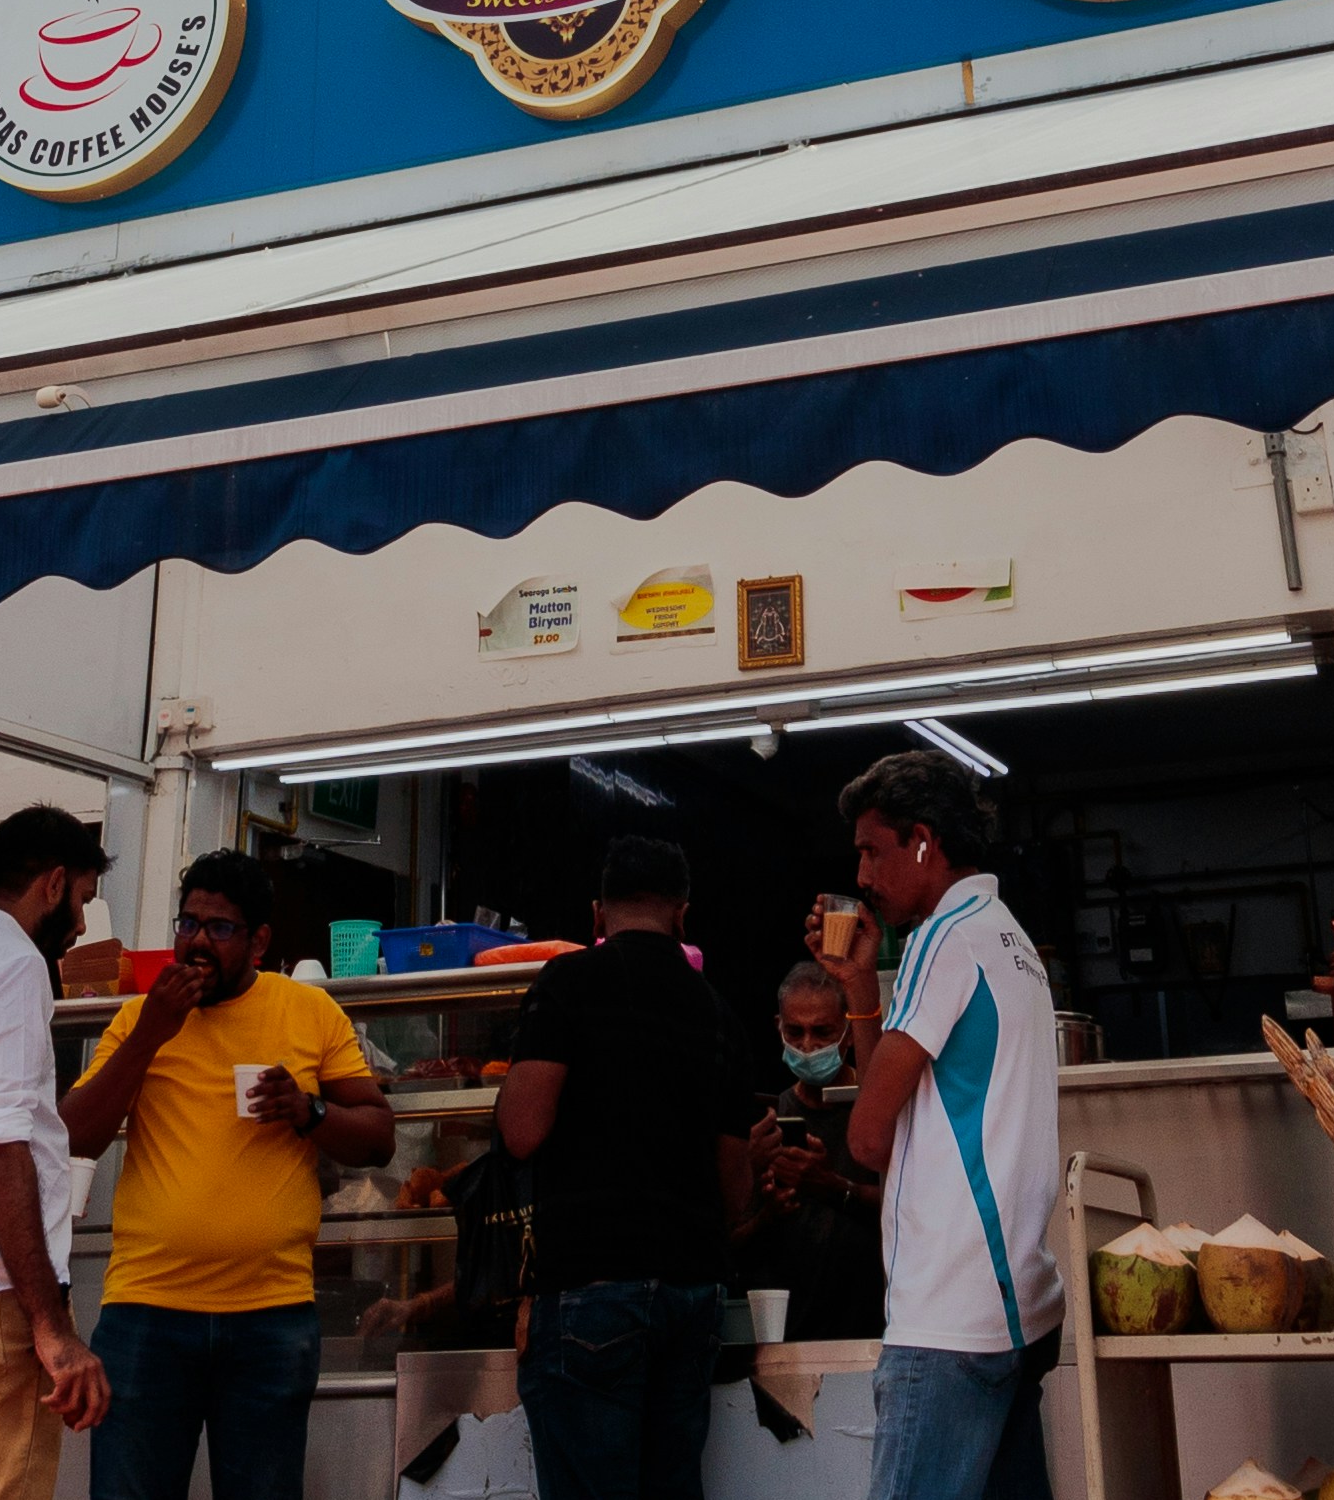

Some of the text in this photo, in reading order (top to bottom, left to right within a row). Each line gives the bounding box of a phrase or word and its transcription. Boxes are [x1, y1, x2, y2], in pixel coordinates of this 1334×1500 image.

[29, 124, 126, 167] COFFEE
[129, 15, 207, 134] HOUSE'S
[529, 601, 571, 615] Mutton
[528, 613, 573, 630] Biryani
[533, 633, 560, 645] $7.00
